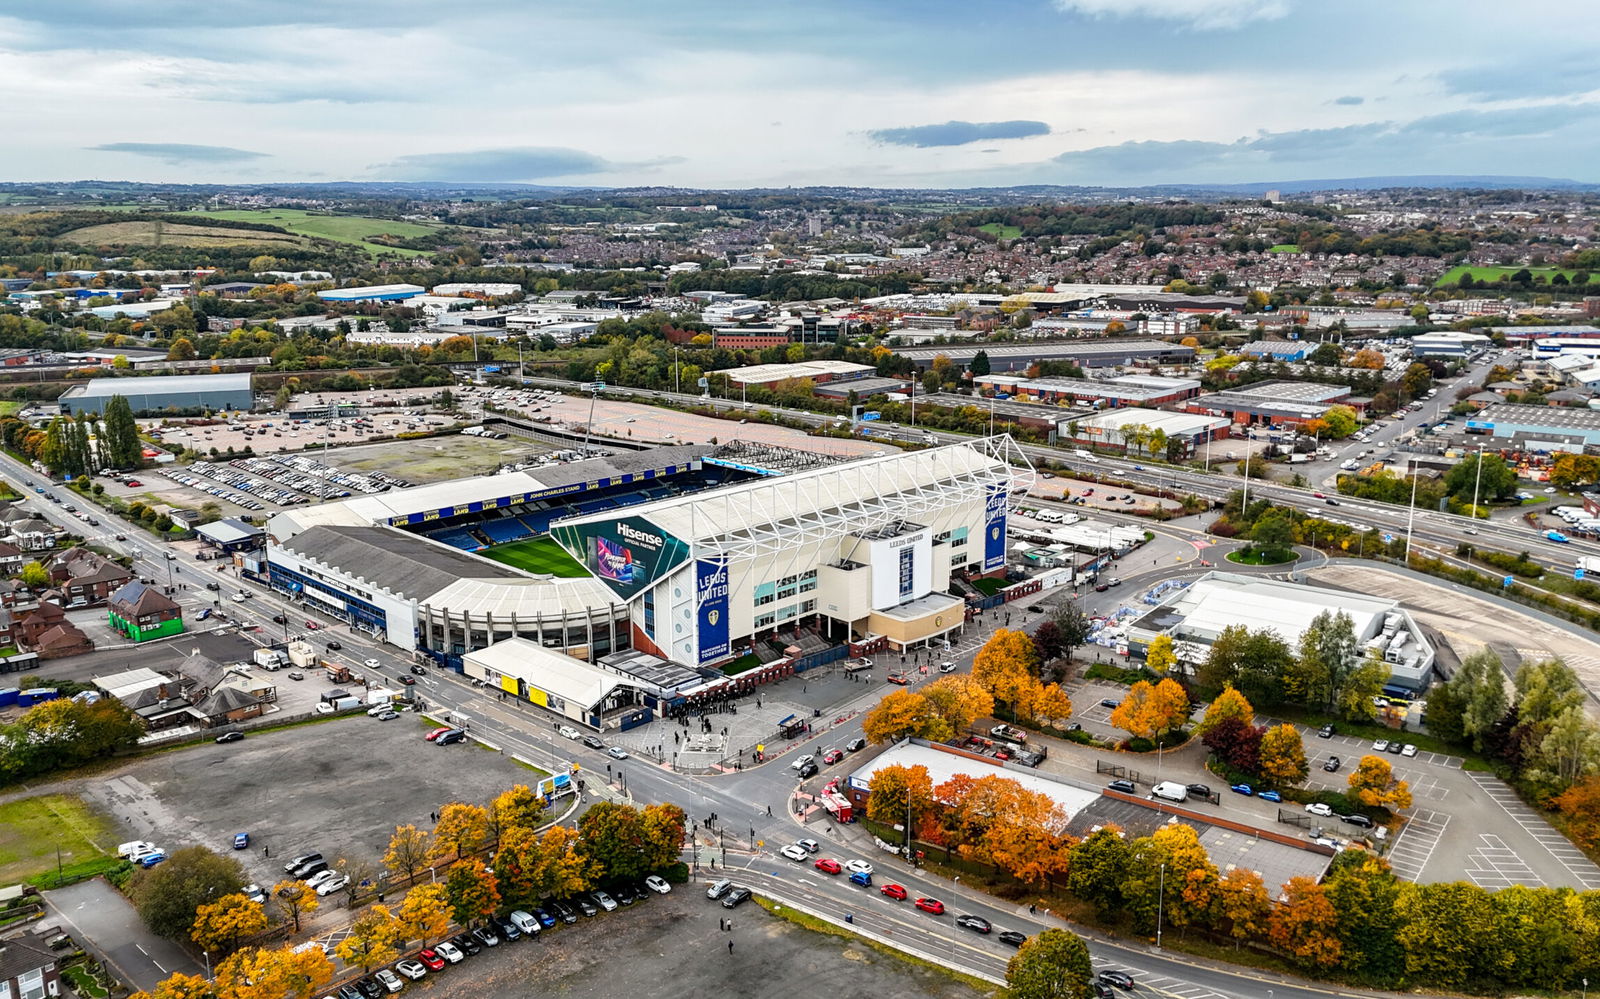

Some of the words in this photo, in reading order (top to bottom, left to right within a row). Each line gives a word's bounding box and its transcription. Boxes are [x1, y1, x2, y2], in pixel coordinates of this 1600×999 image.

[544, 488, 564, 496] CHARLES
[510, 497, 525, 505] LAND
[482, 503, 497, 511] LAND
[454, 508, 469, 516] LAND
[424, 513, 440, 521] LAND
[392, 519, 409, 527] LAND
[617, 522, 663, 547] Hisense
[890, 539, 906, 548] LEEDS
[907, 534, 924, 544] UNITED
[699, 572, 726, 589] LEEDS
[698, 584, 728, 602] UNITED
[701, 647, 727, 659] TOGETHER
